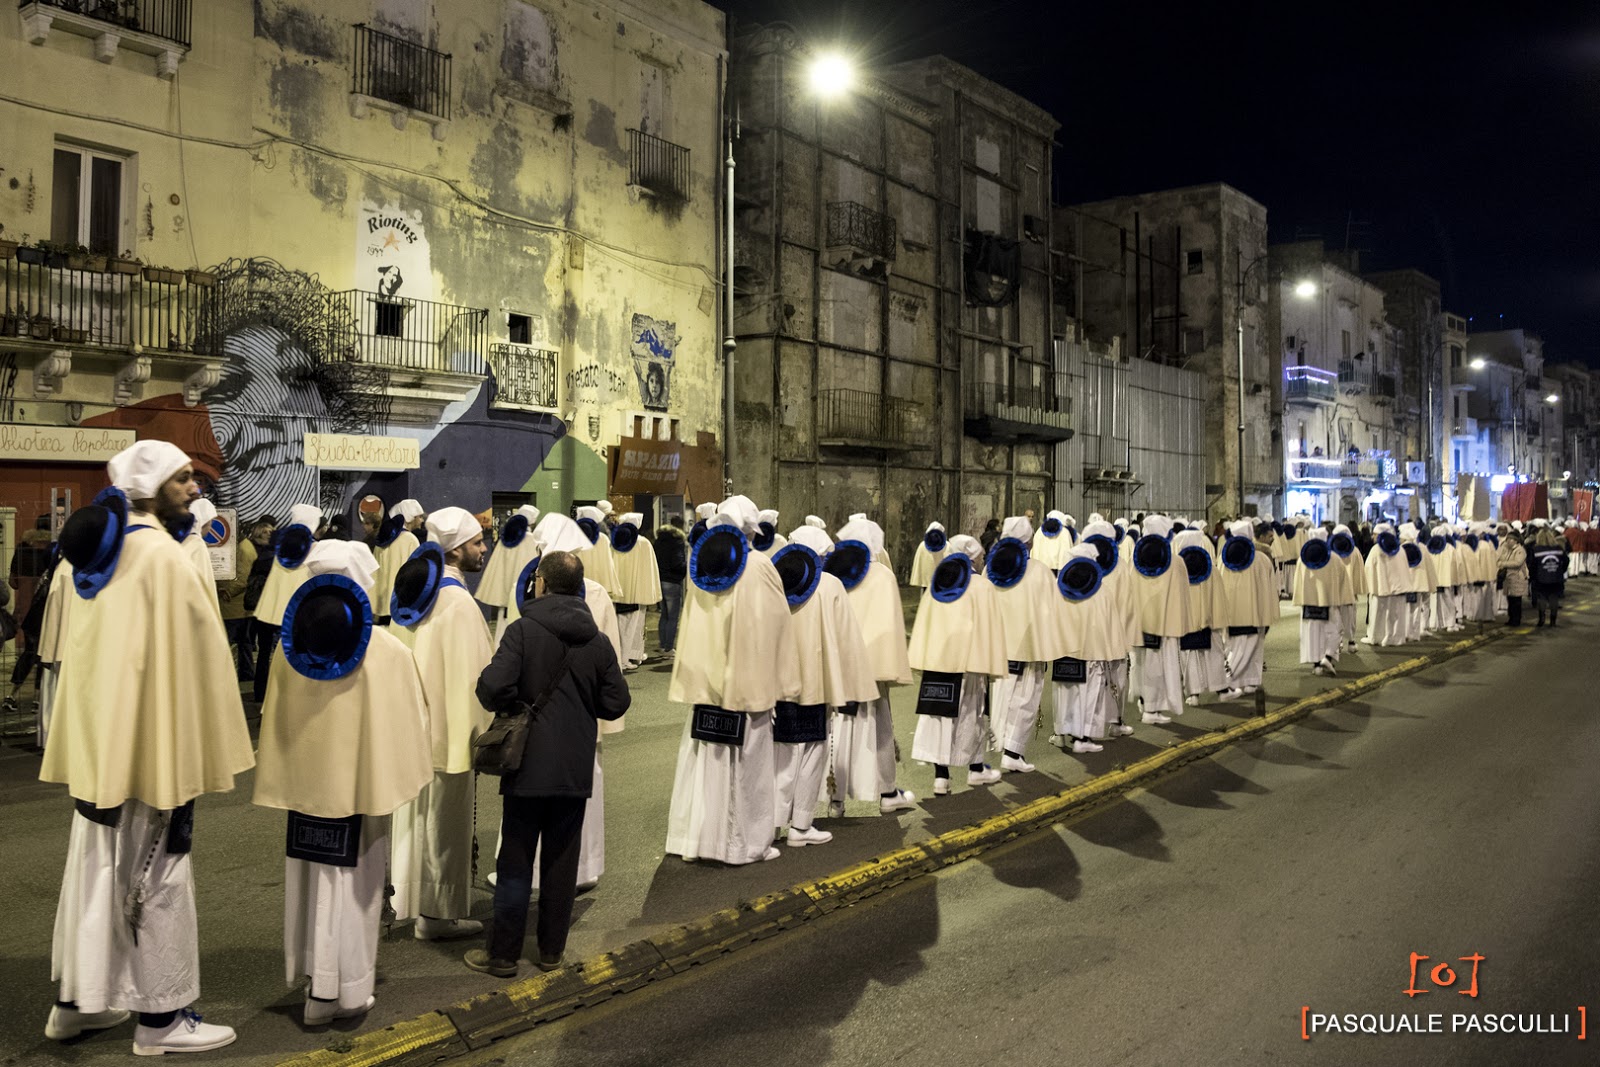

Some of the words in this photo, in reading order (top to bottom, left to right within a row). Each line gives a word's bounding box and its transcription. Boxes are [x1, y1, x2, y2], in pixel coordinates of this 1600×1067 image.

[367, 214, 418, 244] Rioting
[0, 425, 65, 452] blioteca
[72, 430, 128, 455] Popolare
[702, 713, 734, 731] DECOR
